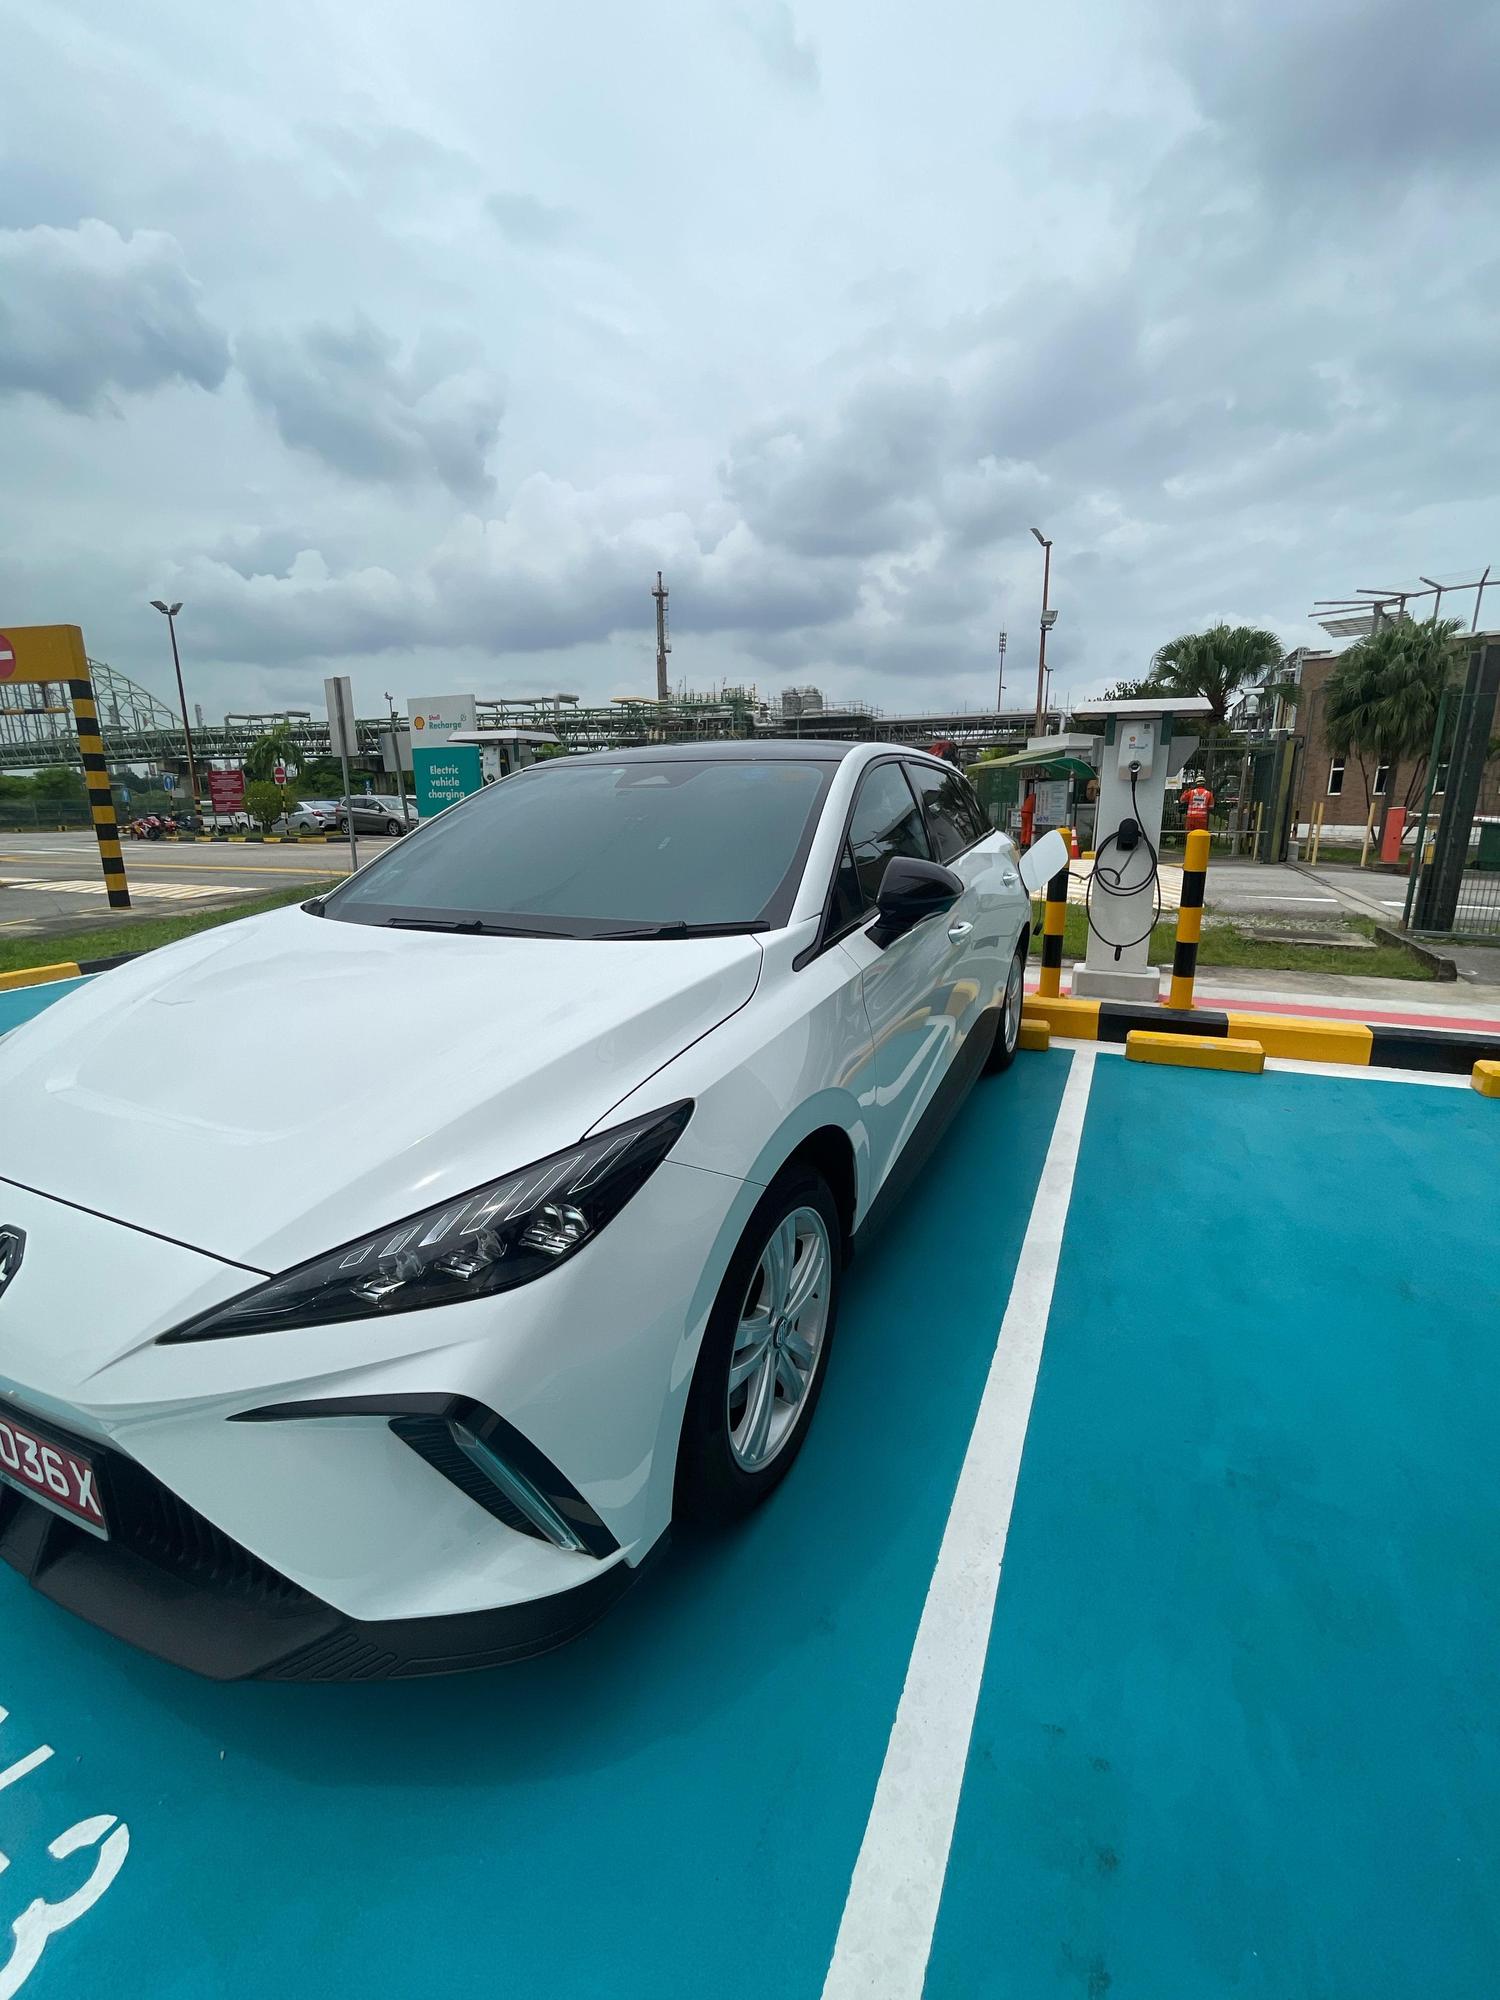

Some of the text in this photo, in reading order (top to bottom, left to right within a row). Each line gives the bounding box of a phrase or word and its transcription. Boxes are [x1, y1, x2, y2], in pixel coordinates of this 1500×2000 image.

[429, 720, 462, 730] Recharge
[430, 764, 459, 775] Electric
[430, 776, 460, 787] vehicle
[428, 788, 465, 801] charging
